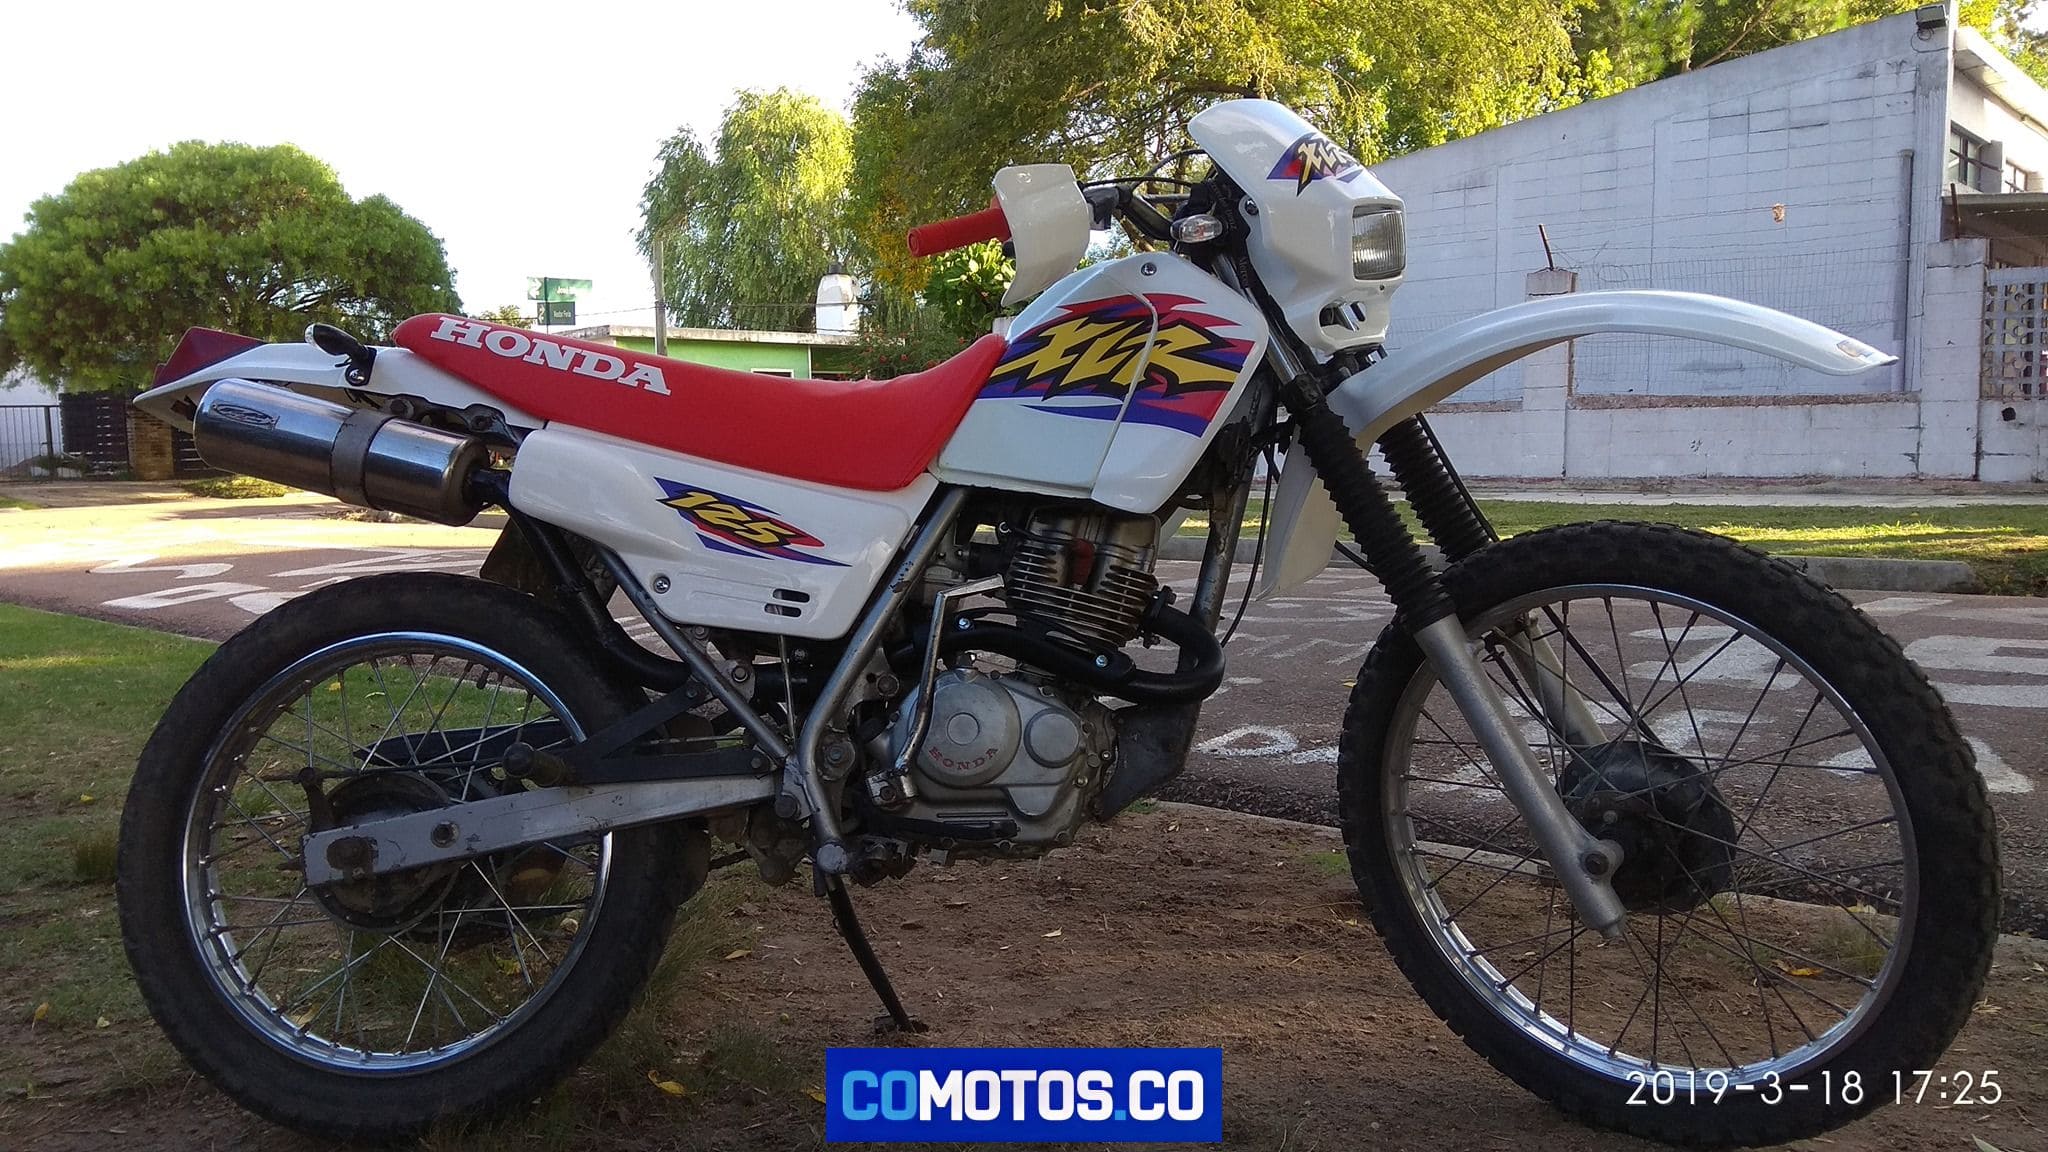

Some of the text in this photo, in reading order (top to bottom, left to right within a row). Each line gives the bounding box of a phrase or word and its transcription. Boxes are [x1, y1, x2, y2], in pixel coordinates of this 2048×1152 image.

[430, 316, 672, 396] HONDA
[985, 314, 1244, 397] XLR
[660, 490, 800, 546] 125
[928, 746, 999, 771] HONDA
